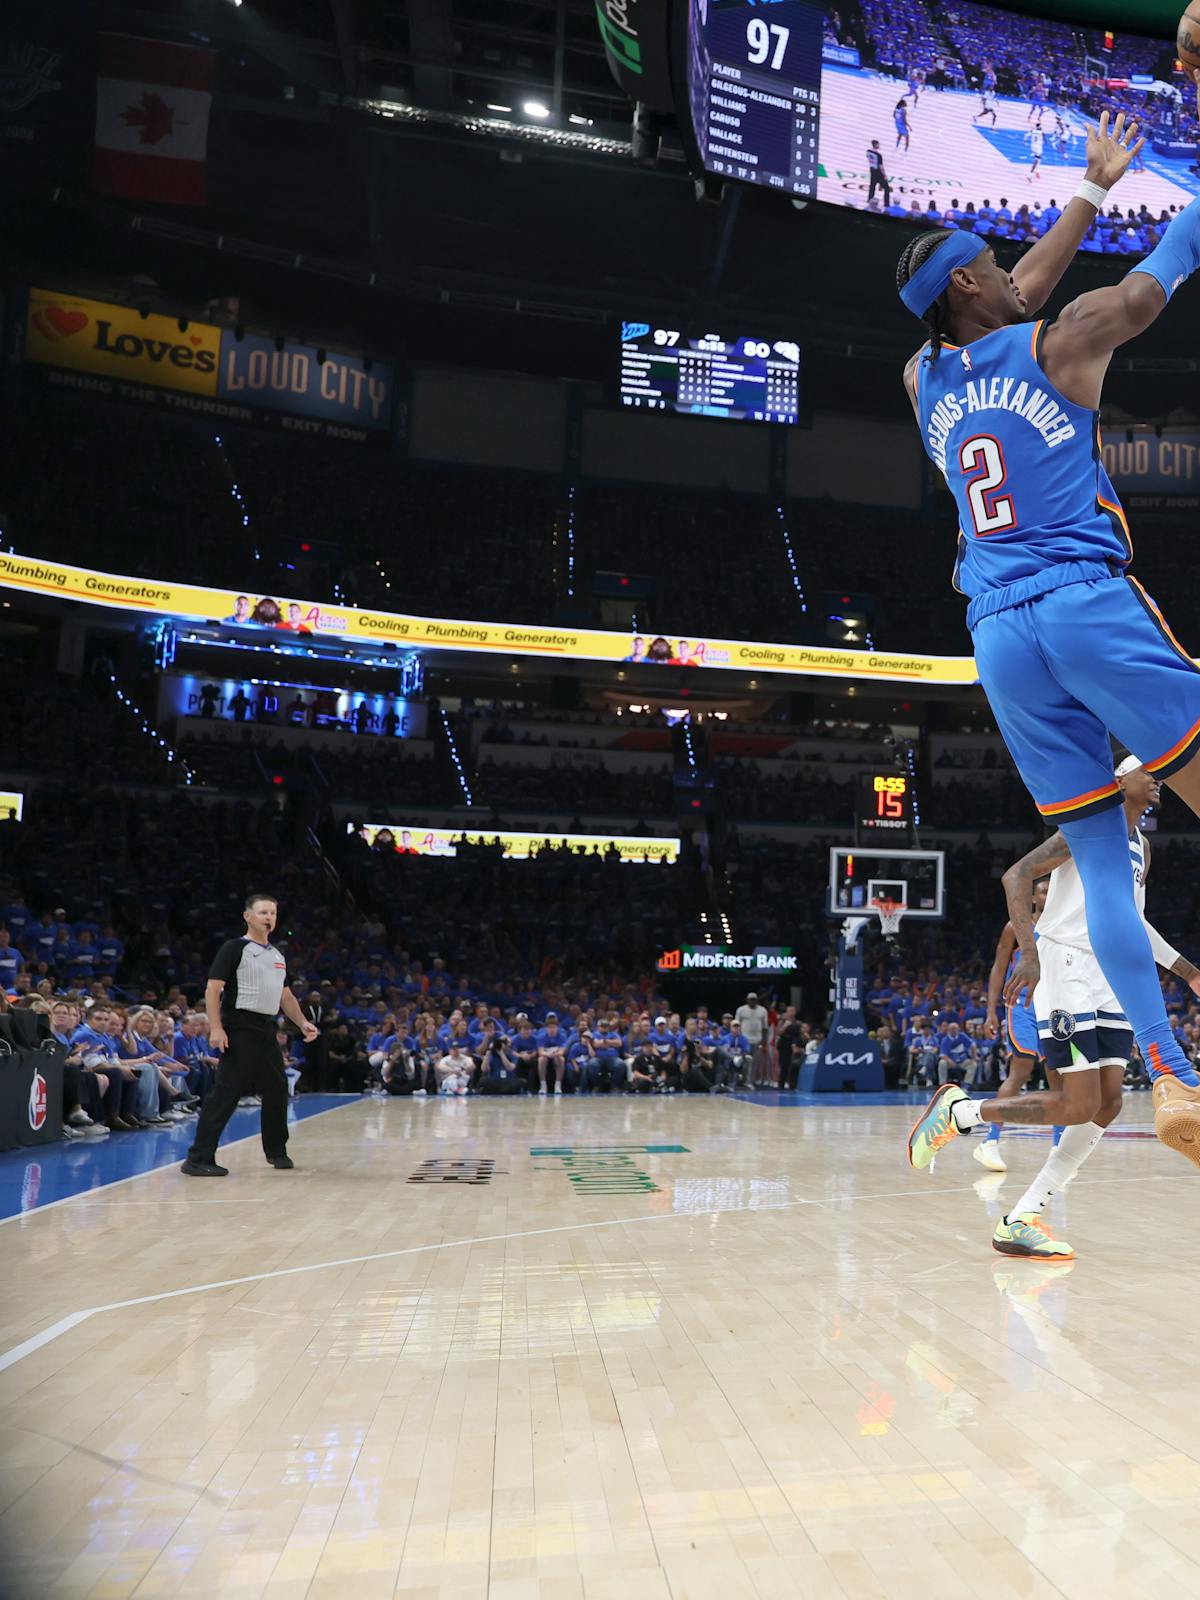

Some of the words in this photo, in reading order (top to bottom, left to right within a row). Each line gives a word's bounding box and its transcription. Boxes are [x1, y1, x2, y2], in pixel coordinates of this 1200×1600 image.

[745, 18, 790, 71] 97
[711, 79, 791, 110] GILGEOUS-ALEXANDER
[713, 63, 741, 79] PLAYER
[793, 87, 807, 99] PTS
[710, 95, 747, 113] WILLIAMS
[796, 119, 805, 129] 17
[710, 111, 741, 127] CARUSO
[709, 126, 743, 144] WALLACE
[708, 143, 759, 165] HARTENSTEIN
[654, 329, 680, 347] 97
[743, 340, 770, 358] 80
[227, 350, 309, 393] LOUD
[320, 359, 386, 419] CITY
[119, 381, 157, 403] THE
[164, 394, 253, 420] THUNDER
[281, 416, 320, 434] EXIT
[326, 425, 368, 442] NOW
[928, 377, 1076, 480] ILGEOUS-ALEXANDER
[1102, 440, 1149, 477] OUD
[960, 434, 1017, 537] 2
[85, 577, 171, 601] Generators
[358, 616, 410, 635] Cooling
[425, 624, 488, 642] Plumbing
[504, 630, 577, 646] Generators
[739, 647, 785, 663] Cooling
[800, 652, 854, 668] Plumbing
[868, 657, 933, 672] Generators
[874, 776, 905, 793] 8:55
[878, 791, 902, 817] 15
[875, 820, 907, 828] TISSOT
[837, 1025, 864, 1036] Google
